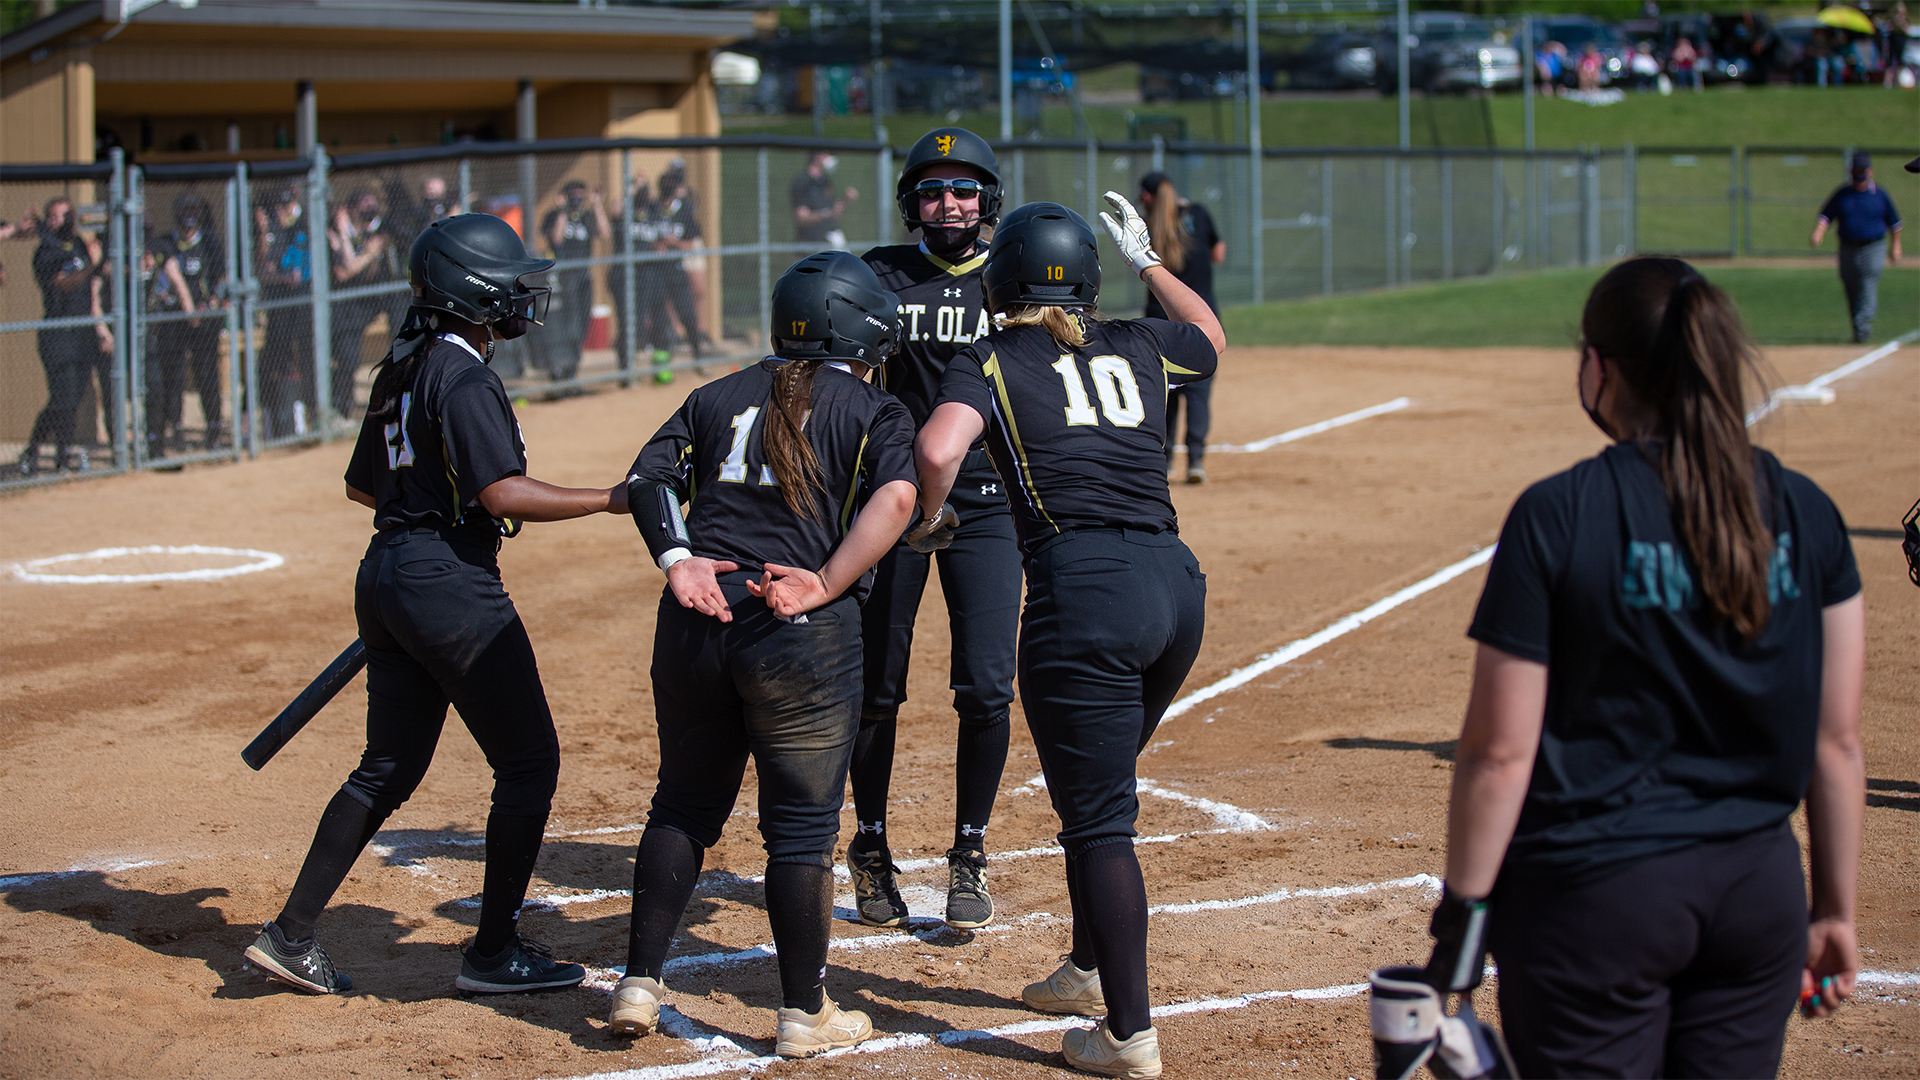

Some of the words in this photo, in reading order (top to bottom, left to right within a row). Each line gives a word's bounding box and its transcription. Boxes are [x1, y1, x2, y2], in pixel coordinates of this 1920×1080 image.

[1047, 266, 1063, 280] 10
[465, 275, 498, 292] RIP-IT
[791, 321, 806, 336] 17
[865, 316, 889, 332] RIP-IT
[1052, 353, 1145, 427] 10
